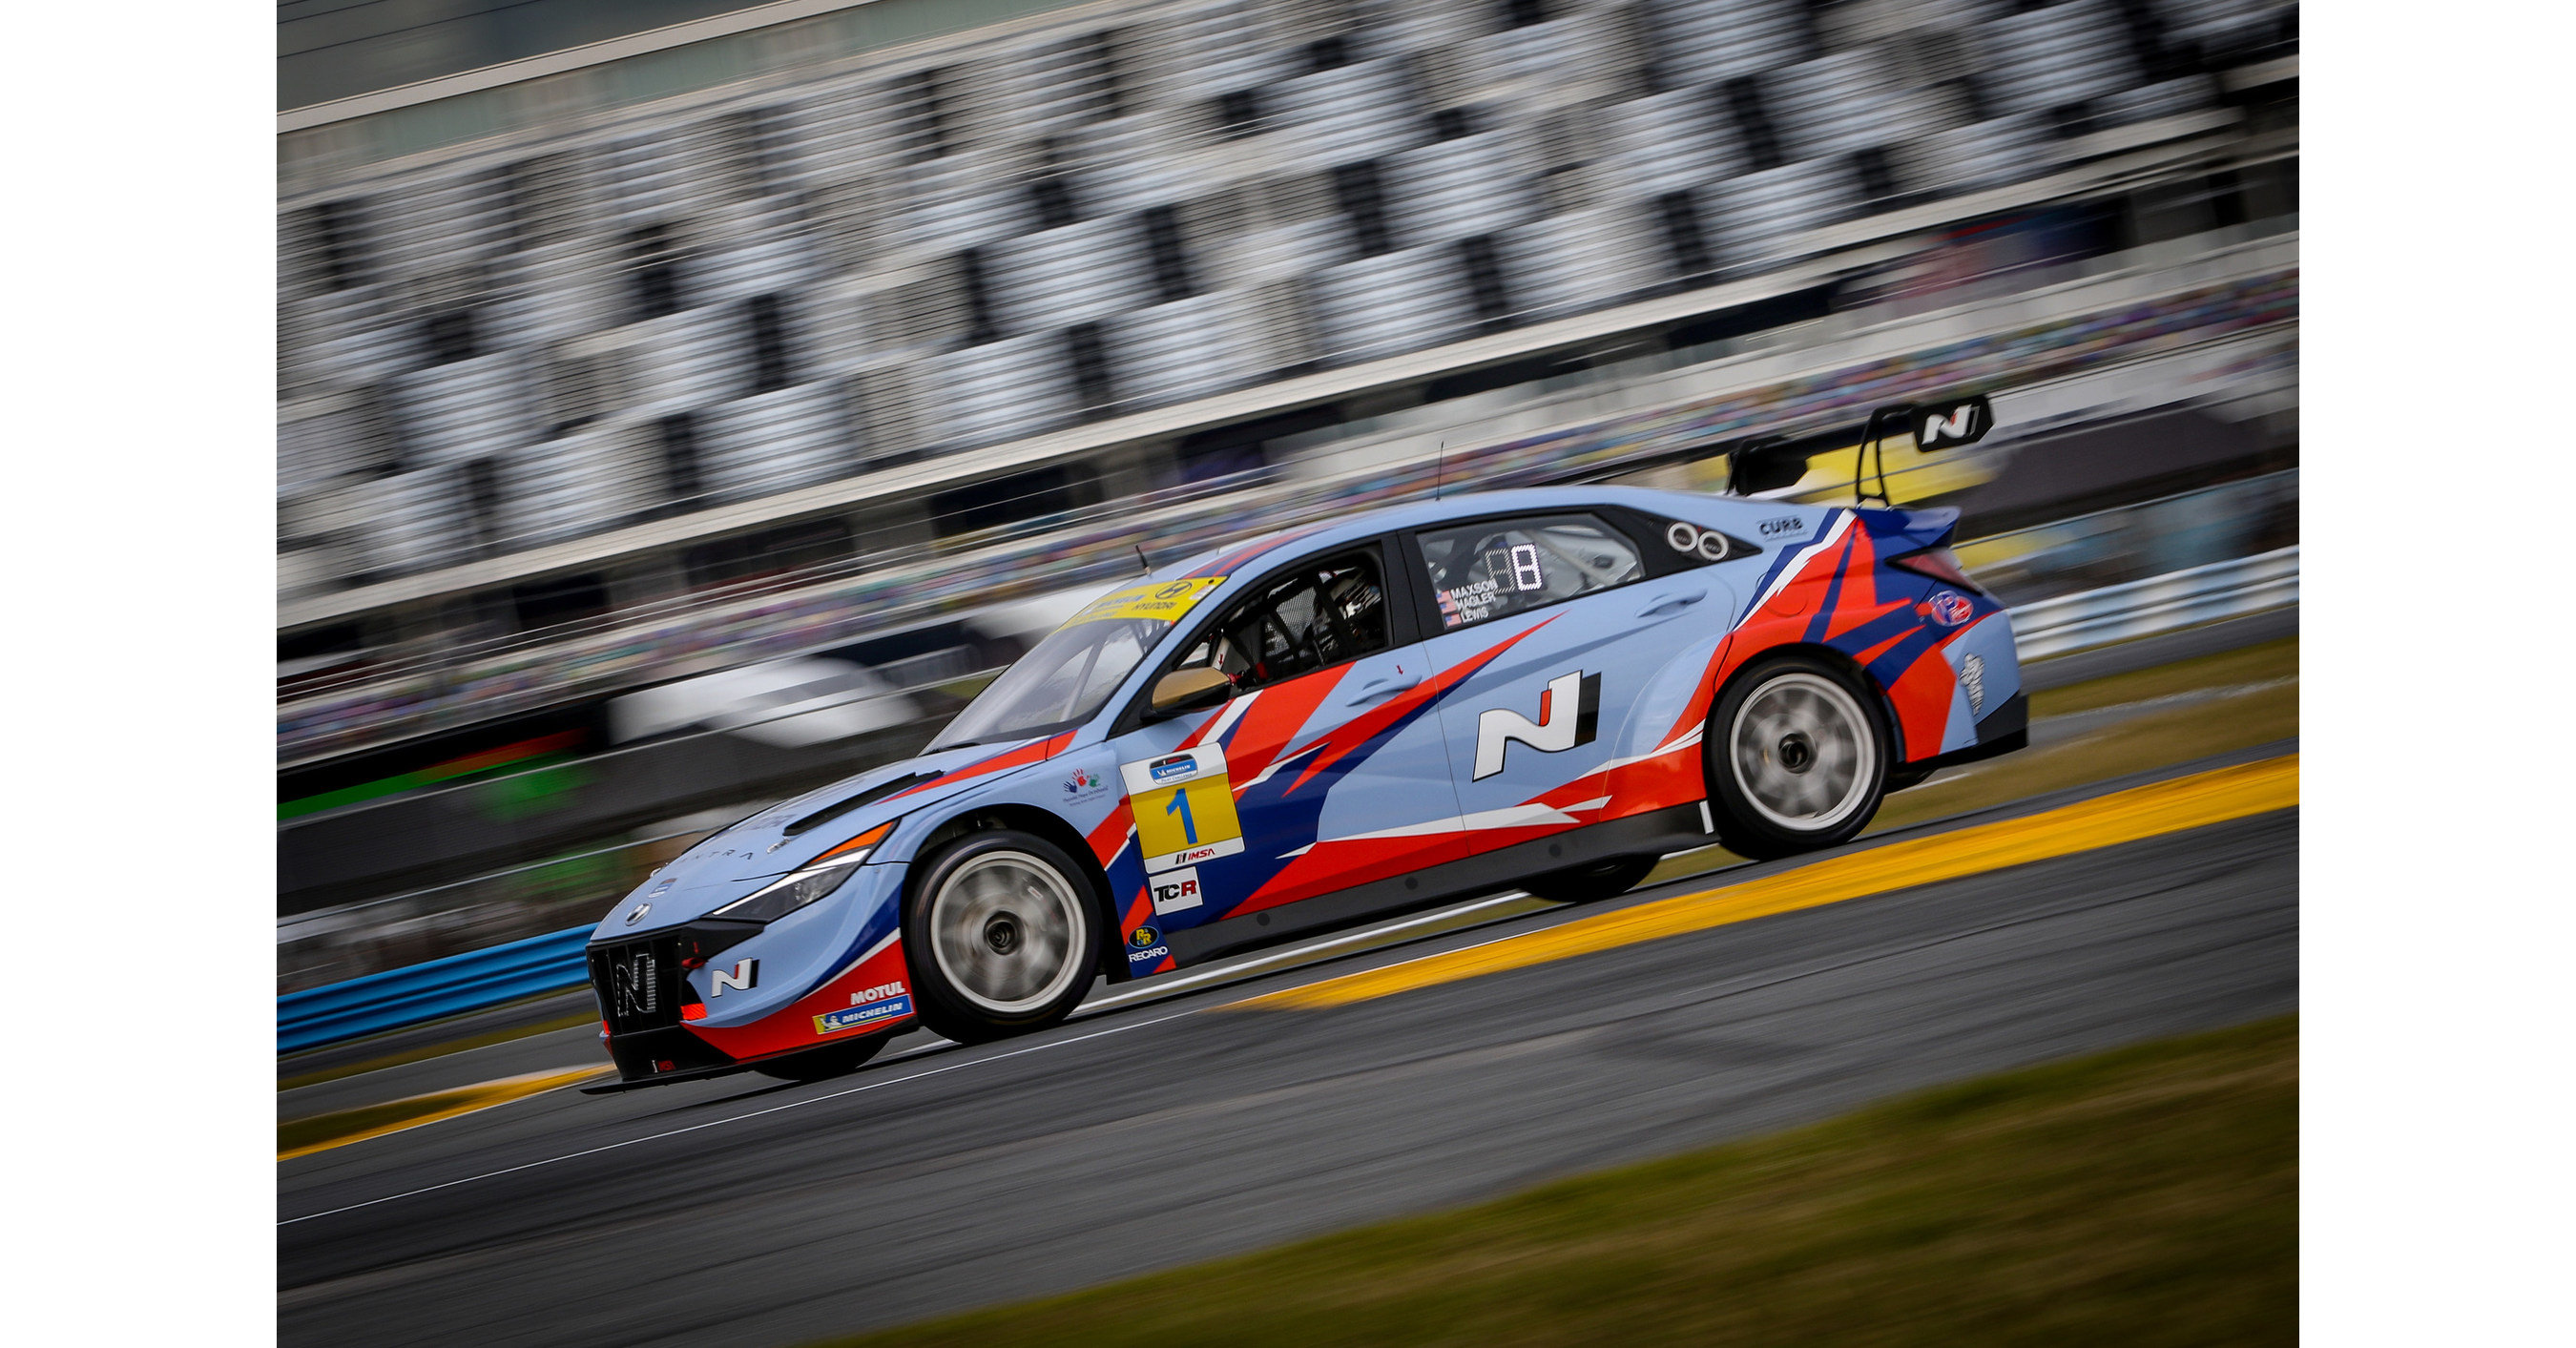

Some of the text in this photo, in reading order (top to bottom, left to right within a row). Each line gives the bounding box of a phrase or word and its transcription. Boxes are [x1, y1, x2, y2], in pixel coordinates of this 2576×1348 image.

[1922, 404, 1981, 445] N
[1759, 517, 1803, 534] CURB
[1450, 578, 1499, 599] MAXSON
[1460, 607, 1488, 623] LEWIS
[1472, 670, 1602, 782] N
[1166, 788, 1198, 845] 1
[1188, 848, 1215, 861] IMSA
[1153, 880, 1197, 902] TCR
[1128, 946, 1169, 963] RECARO
[711, 957, 759, 998] N
[850, 981, 905, 1006] MOTUL
[841, 1002, 903, 1024] MICHELIN
